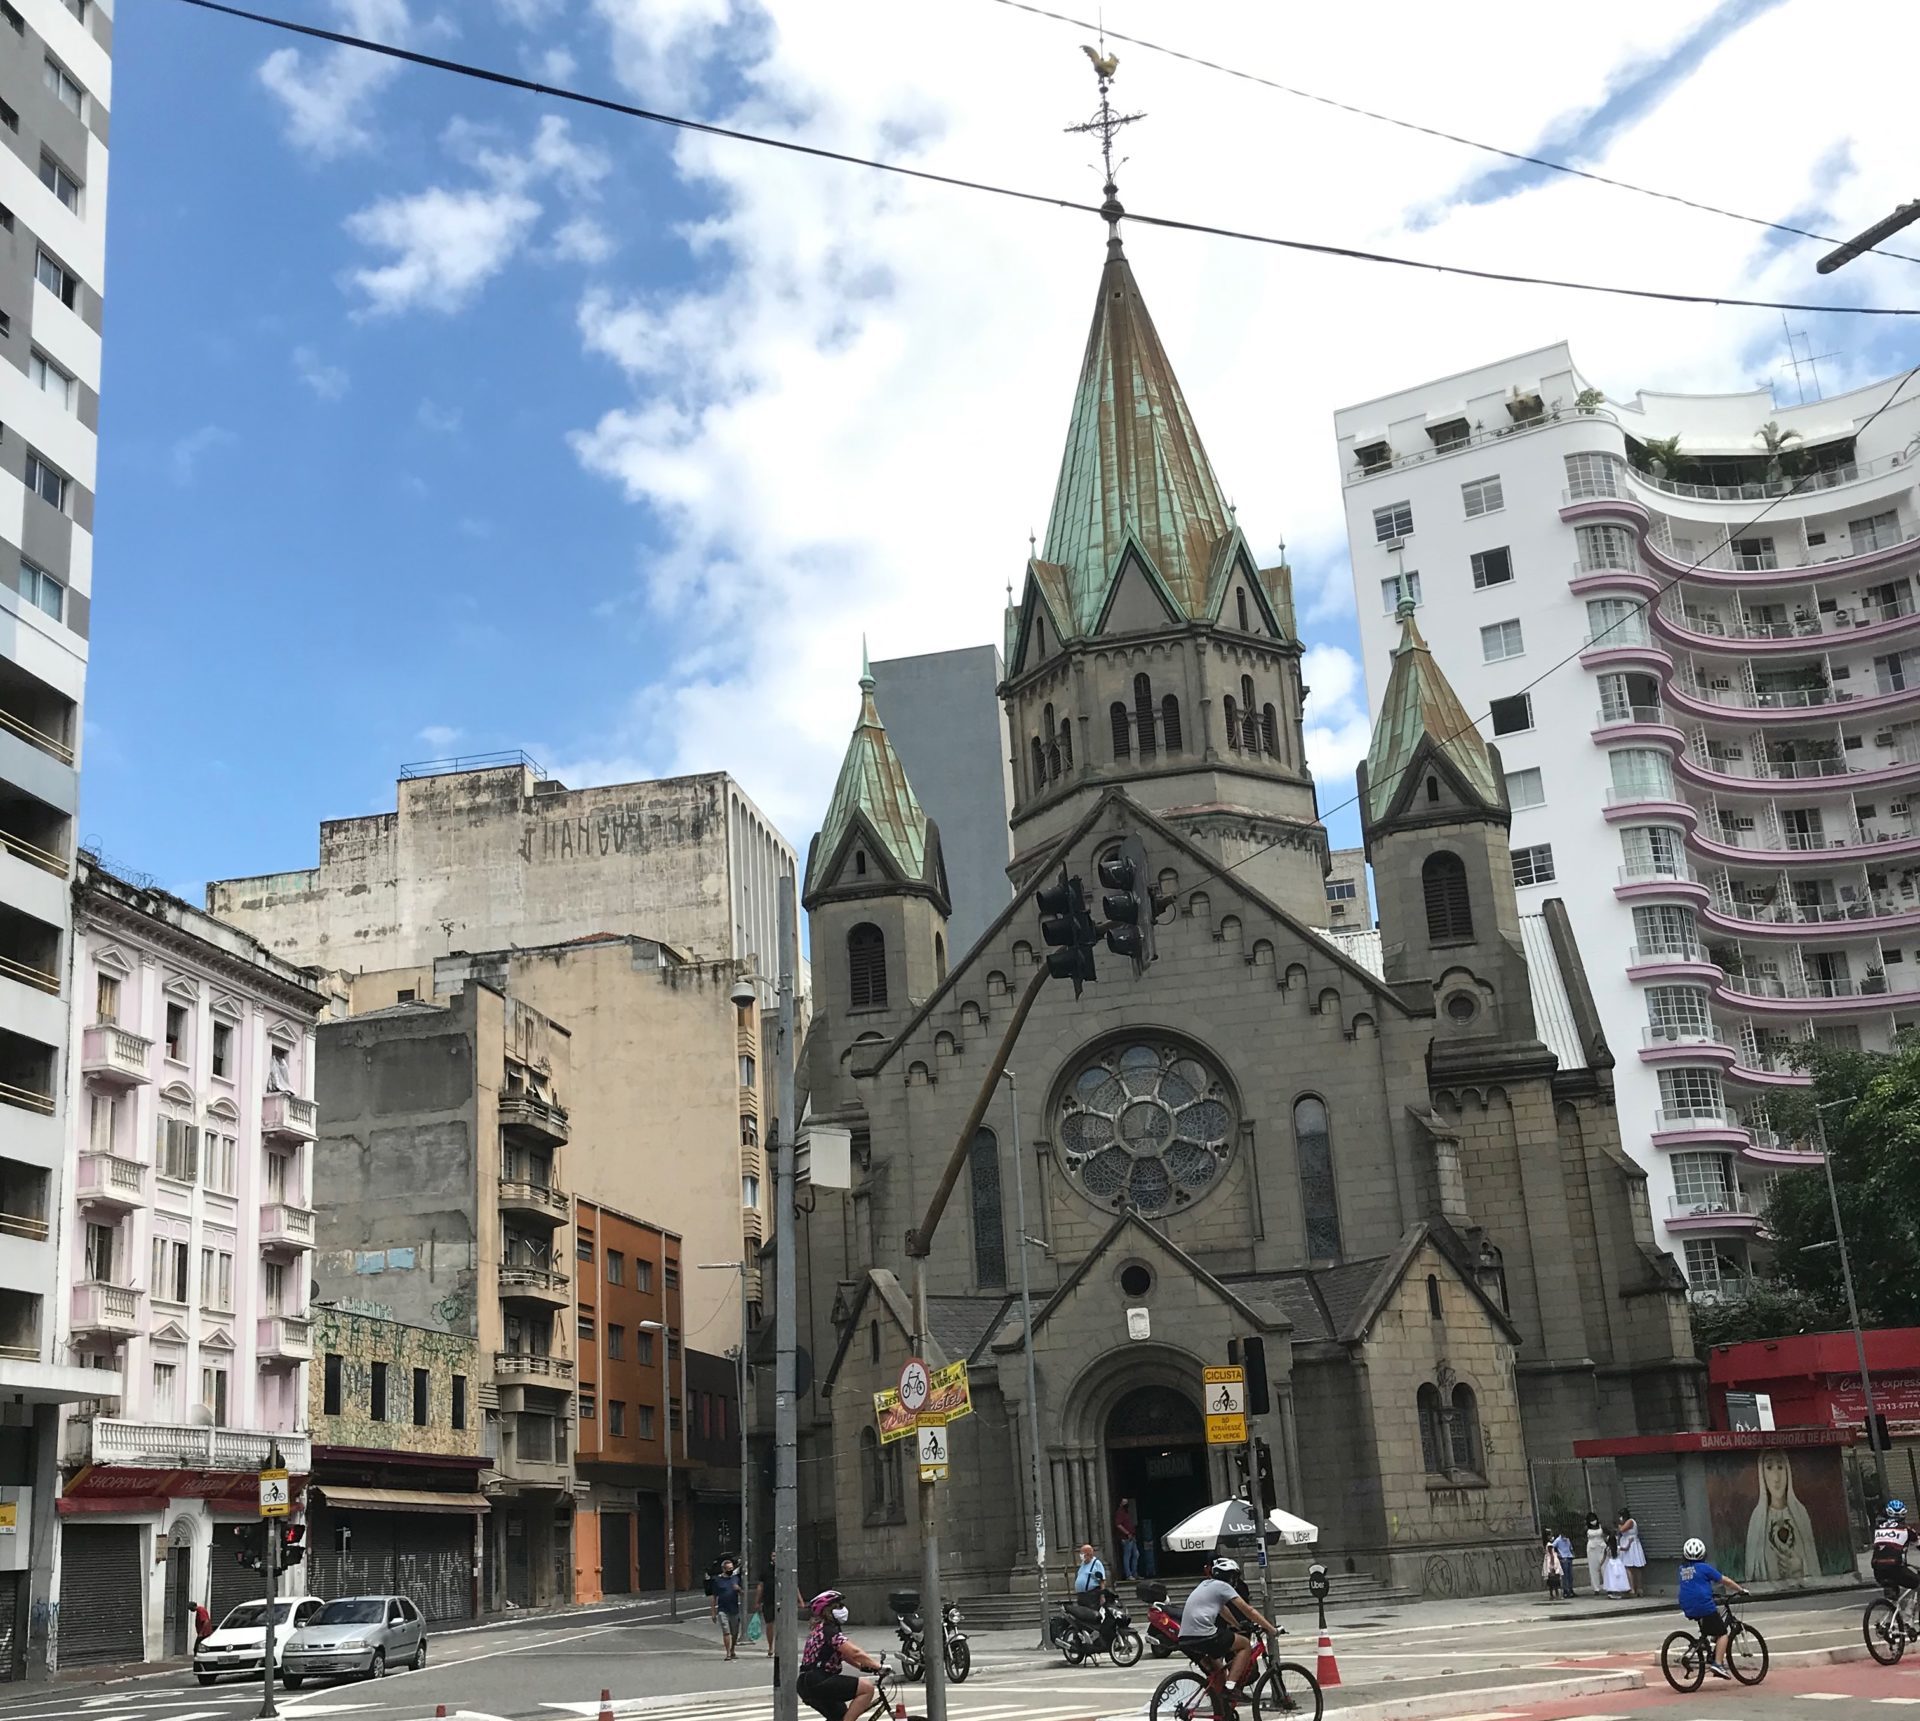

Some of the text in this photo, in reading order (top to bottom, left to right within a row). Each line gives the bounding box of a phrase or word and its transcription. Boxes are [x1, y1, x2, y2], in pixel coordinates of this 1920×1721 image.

[1205, 1370, 1242, 1380] CICLISTA
[1701, 1434, 1732, 1448] BANCA
[1734, 1433, 1763, 1447] NOSSA
[1765, 1431, 1807, 1446] SENHORA
[1808, 1431, 1820, 1443] DE
[1293, 1530, 1311, 1542] Uber
[1180, 1538, 1205, 1550] Uber
[1311, 1580, 1325, 1589] Uber
